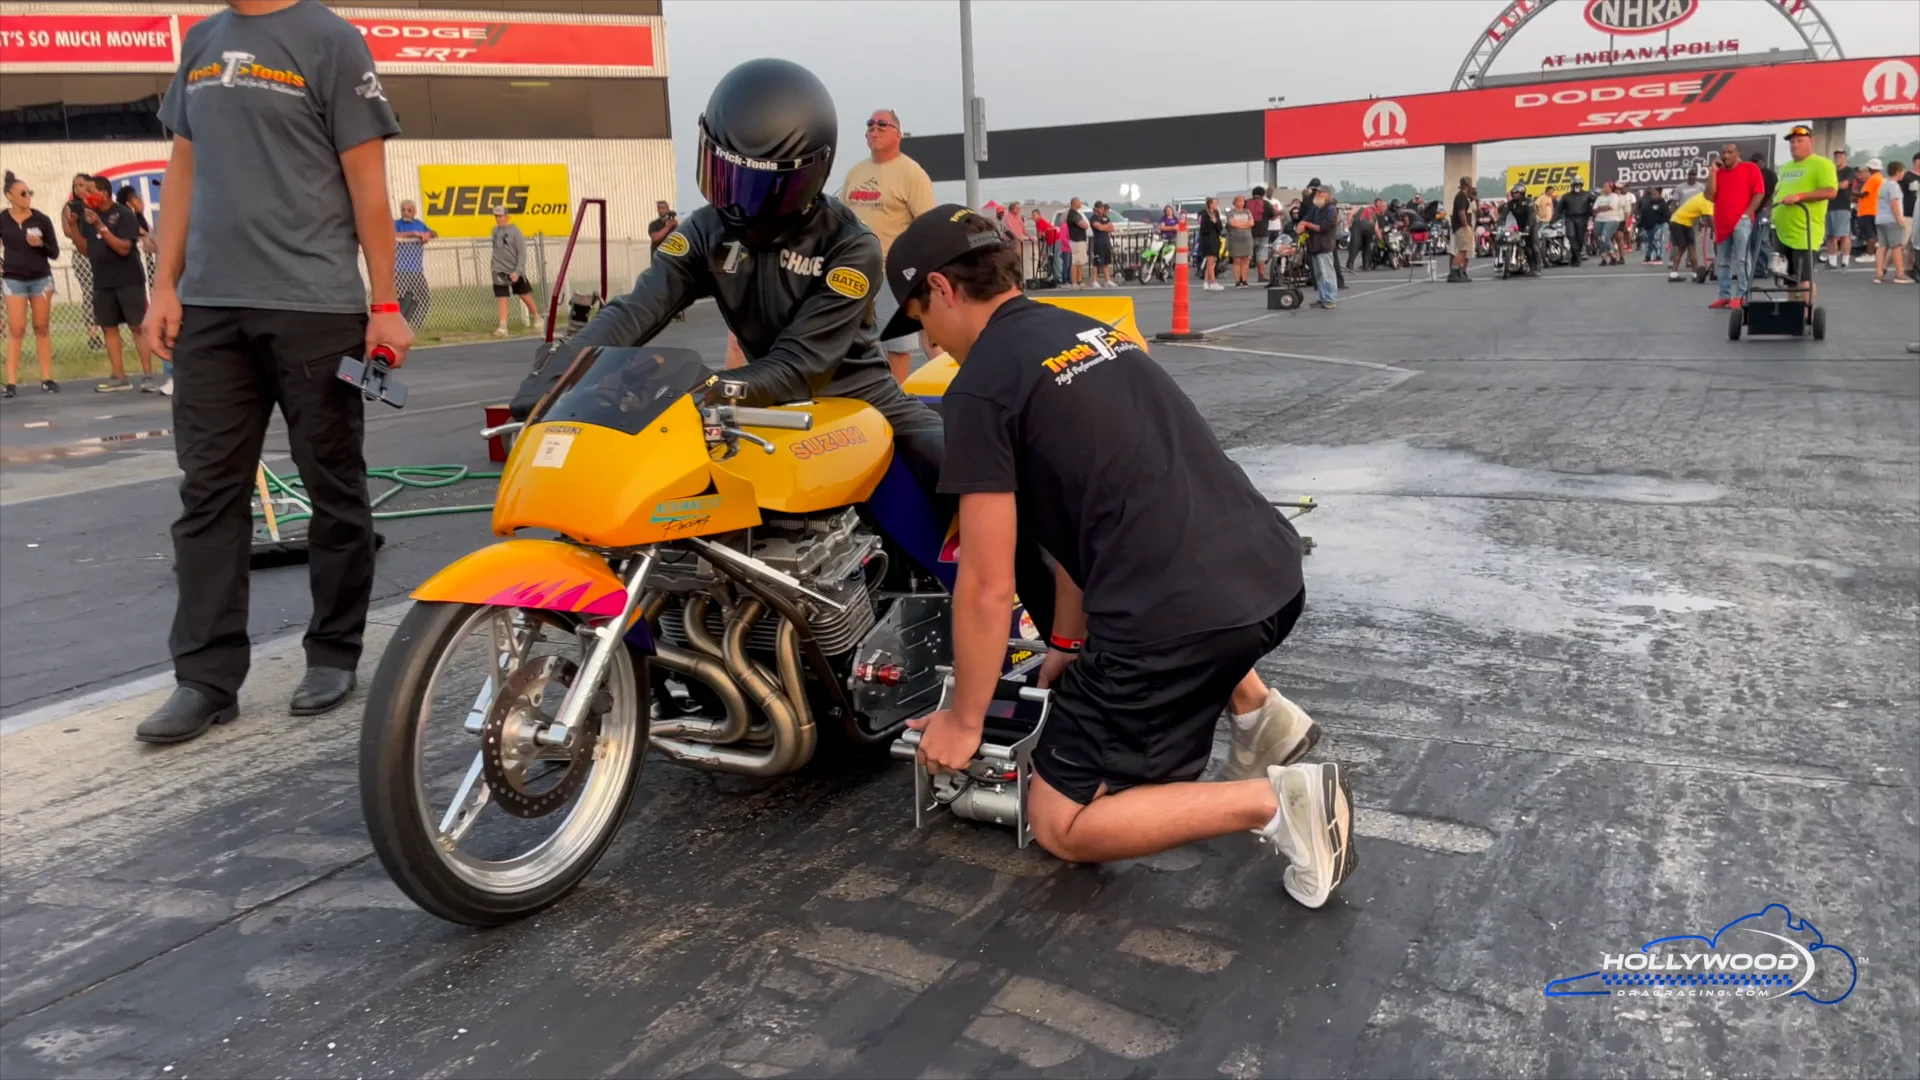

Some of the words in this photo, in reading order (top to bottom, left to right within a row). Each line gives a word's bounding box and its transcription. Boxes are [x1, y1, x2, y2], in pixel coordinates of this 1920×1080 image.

[1601, 0, 1684, 28] NHRA
[0, 30, 25, 47] T'S
[28, 30, 50, 47] SO
[55, 30, 101, 47] MUCH
[106, 31, 168, 47] MOWER
[396, 46, 478, 62] SRT
[1542, 54, 1565, 67] AT
[1575, 39, 1740, 65] INDIANAPOLIS
[1514, 79, 1703, 108] DODGE
[1577, 107, 1687, 127] SRT
[715, 146, 778, 170] Trick-Tools
[1616, 148, 1682, 161] WELCOME
[1683, 146, 1700, 157] TO
[1517, 166, 1580, 185] JEGS
[1632, 162, 1661, 170] TOWN
[1665, 160, 1679, 168] OF
[779, 249, 825, 277] CHASE
[832, 273, 866, 292] BATES
[789, 425, 867, 460] SUZUKI
[661, 514, 711, 538] Racing
